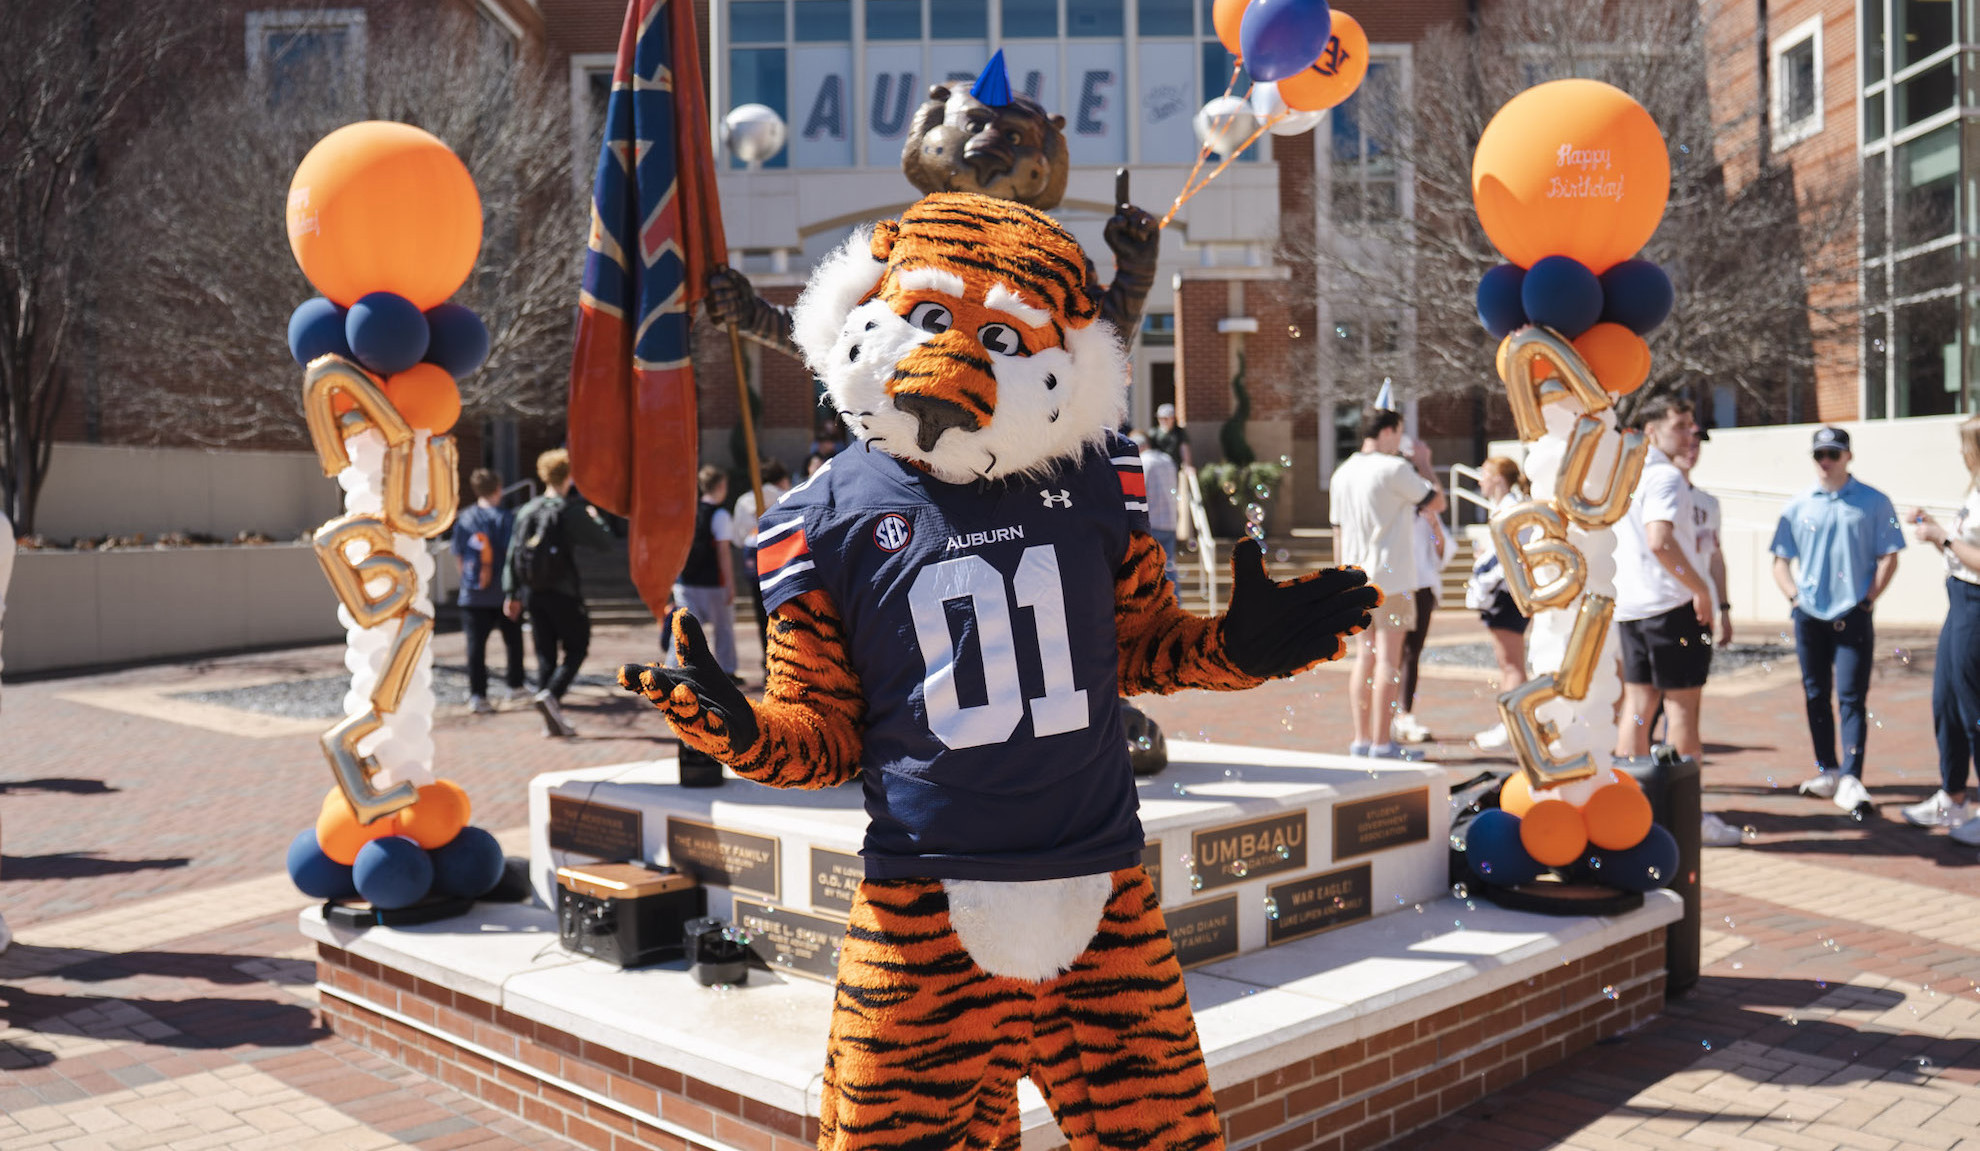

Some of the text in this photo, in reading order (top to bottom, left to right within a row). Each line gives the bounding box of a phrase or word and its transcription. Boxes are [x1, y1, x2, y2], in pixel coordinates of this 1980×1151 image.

[1556, 143, 1611, 171] Happy
[875, 516, 909, 550] SEC
[945, 524, 1025, 552] AUBURN
[907, 543, 1090, 751] 01
[733, 844, 770, 864] FAMILY
[1201, 822, 1303, 867] UMB4AU
[1291, 889, 1315, 906] WAR
[1172, 915, 1228, 939] AND DIANE
[1182, 931, 1219, 948] FAMILY
